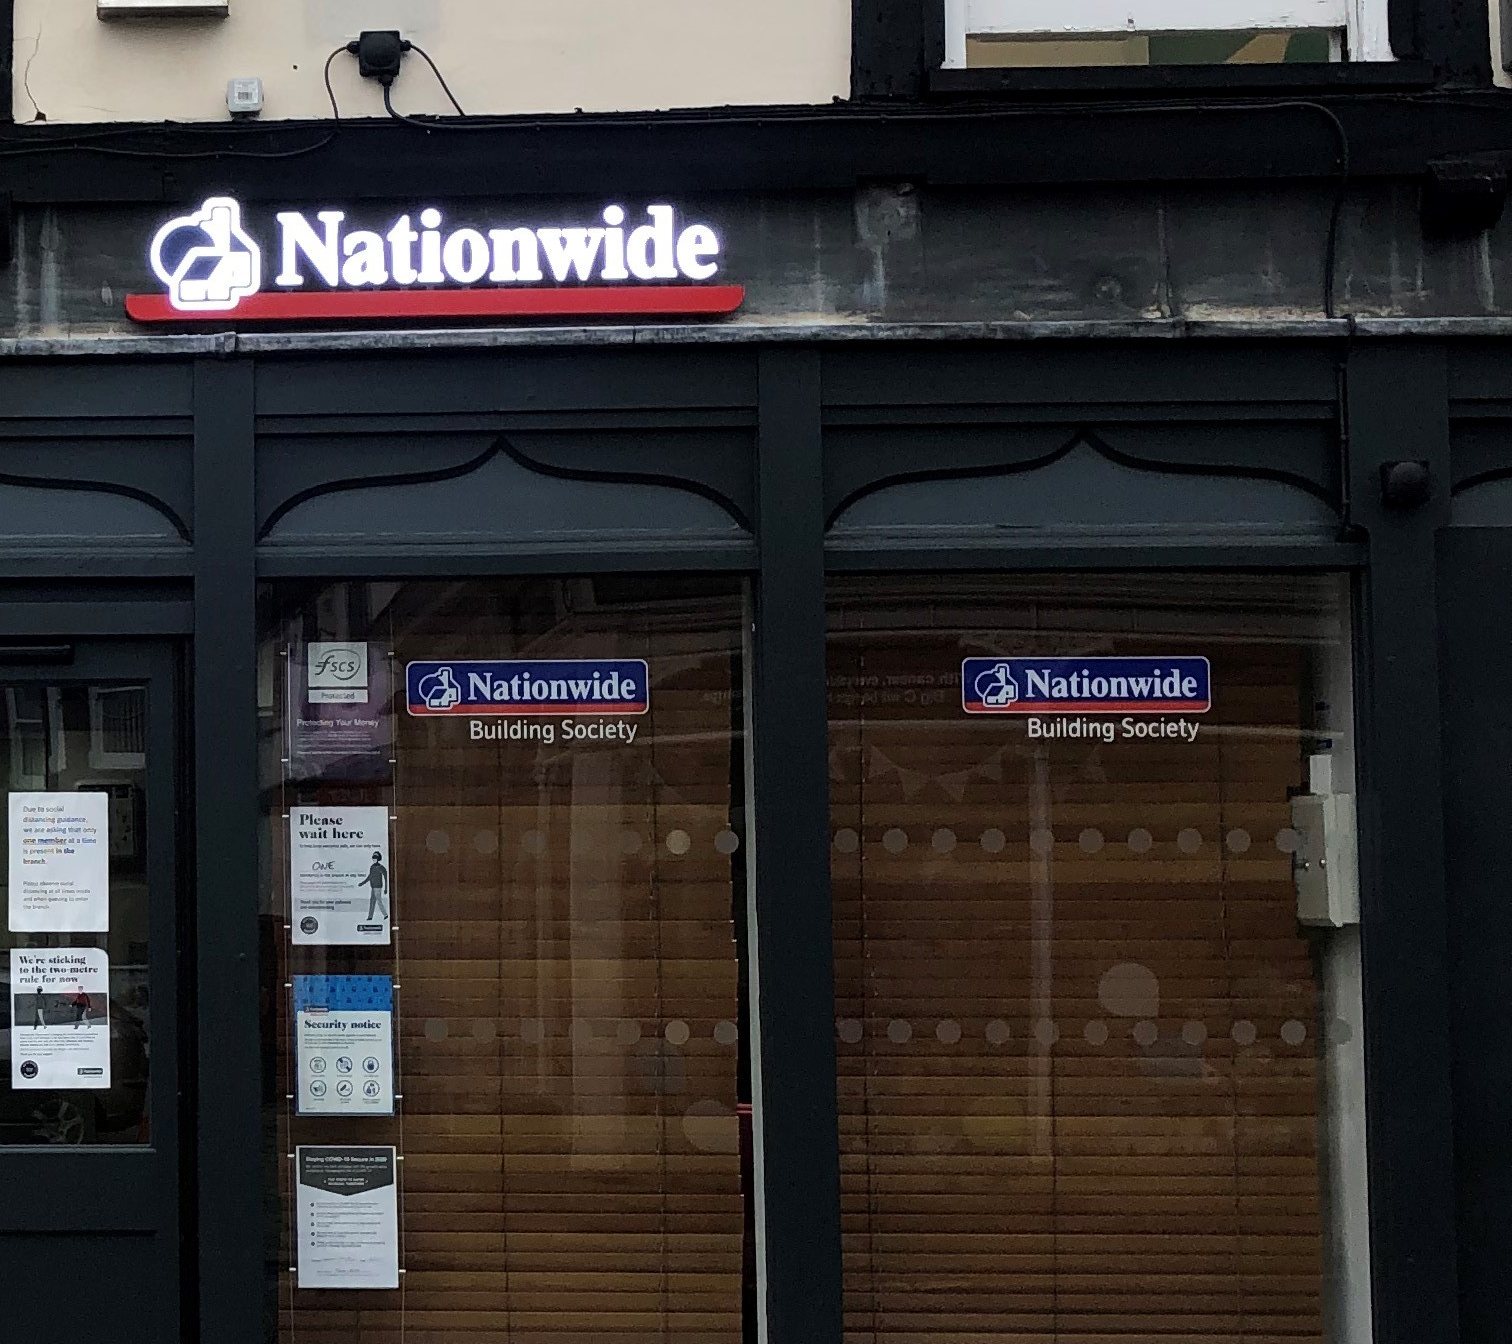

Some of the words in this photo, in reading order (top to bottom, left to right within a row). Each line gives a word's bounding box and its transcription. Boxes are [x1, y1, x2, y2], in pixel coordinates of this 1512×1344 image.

[275, 205, 720, 287] Nationwide
[467, 671, 636, 701] Nationwide
[1025, 668, 1198, 699] Nationwide
[321, 692, 355, 700] Protected
[297, 718, 333, 727] Protecting
[354, 718, 379, 728] Money
[470, 719, 555, 744] Building
[561, 719, 638, 744] Society
[1028, 718, 1116, 742] Building
[1122, 717, 1199, 742] Society
[299, 814, 343, 826] Please
[299, 827, 328, 839] wait
[332, 827, 364, 839] here
[312, 860, 336, 871] ONE
[19, 955, 46, 964] We're
[49, 955, 86, 965] sticking
[20, 975, 39, 983] rule
[42, 975, 56, 983] for
[304, 1019, 347, 1031] Security
[350, 1019, 382, 1029] notice
